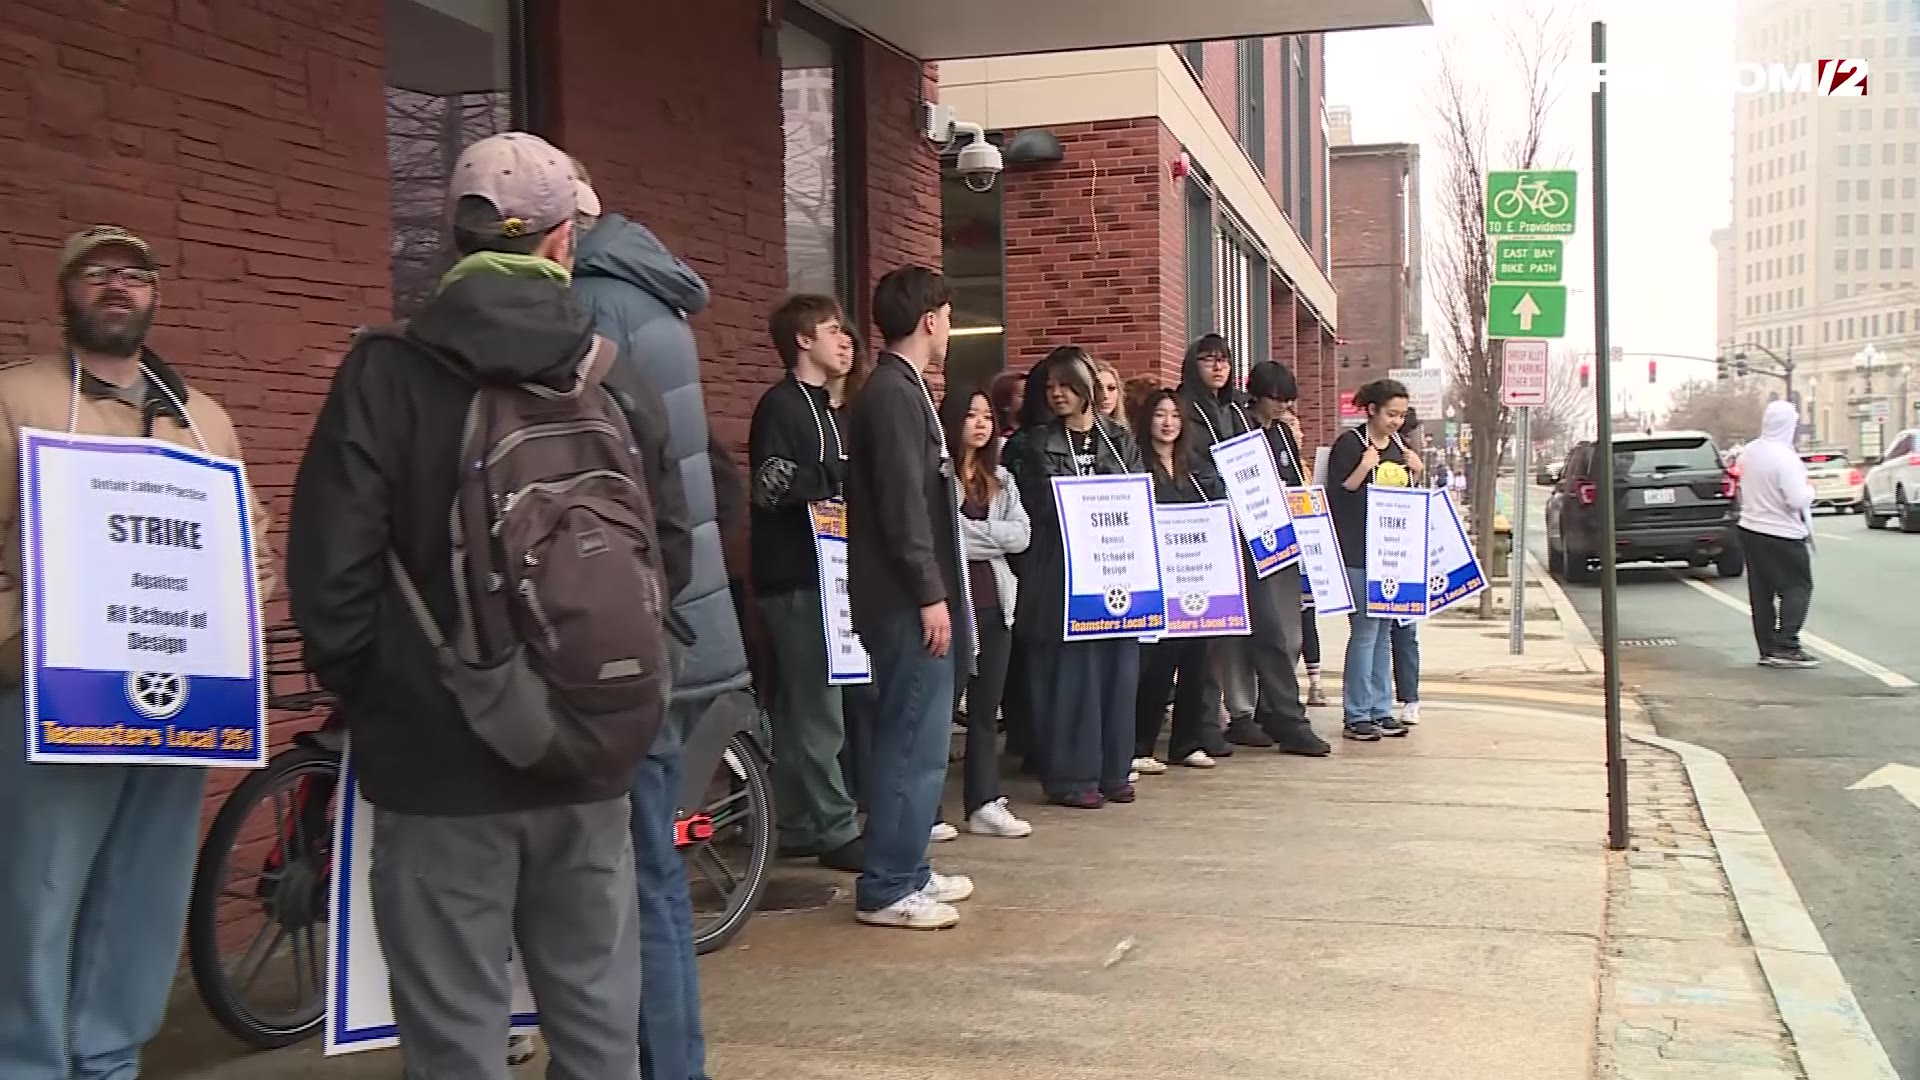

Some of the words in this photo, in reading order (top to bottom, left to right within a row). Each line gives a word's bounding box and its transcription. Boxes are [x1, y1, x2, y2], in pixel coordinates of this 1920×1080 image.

[1488, 220, 1501, 233] TO
[1507, 221, 1515, 233] E
[1519, 220, 1573, 233] Providence
[1503, 248, 1528, 259] EAST
[1533, 248, 1555, 259] BAY
[1501, 263, 1524, 274] BIKE
[1529, 263, 1557, 274] PATH
[1234, 464, 1261, 482] STRIKE
[90, 477, 130, 492] Unfair
[130, 480, 164, 494] Labor
[164, 482, 208, 502] Practice
[1090, 512, 1130, 527] STRIKE
[1379, 516, 1407, 529] STRIKE
[107, 514, 204, 550] STRIKE
[1164, 532, 1208, 545] STRIKE
[1102, 566, 1127, 576] Design
[130, 572, 189, 592] Against
[106, 604, 127, 624] RI
[129, 606, 189, 628] School
[190, 610, 208, 630] of
[1071, 618, 1121, 631] Teamsters
[1122, 616, 1146, 629] Local
[1148, 614, 1163, 626] 251
[1200, 617, 1226, 628] Local
[127, 632, 188, 656] Design
[40, 721, 162, 747] Teamsters
[165, 724, 218, 749] Local
[219, 726, 254, 751] 251
